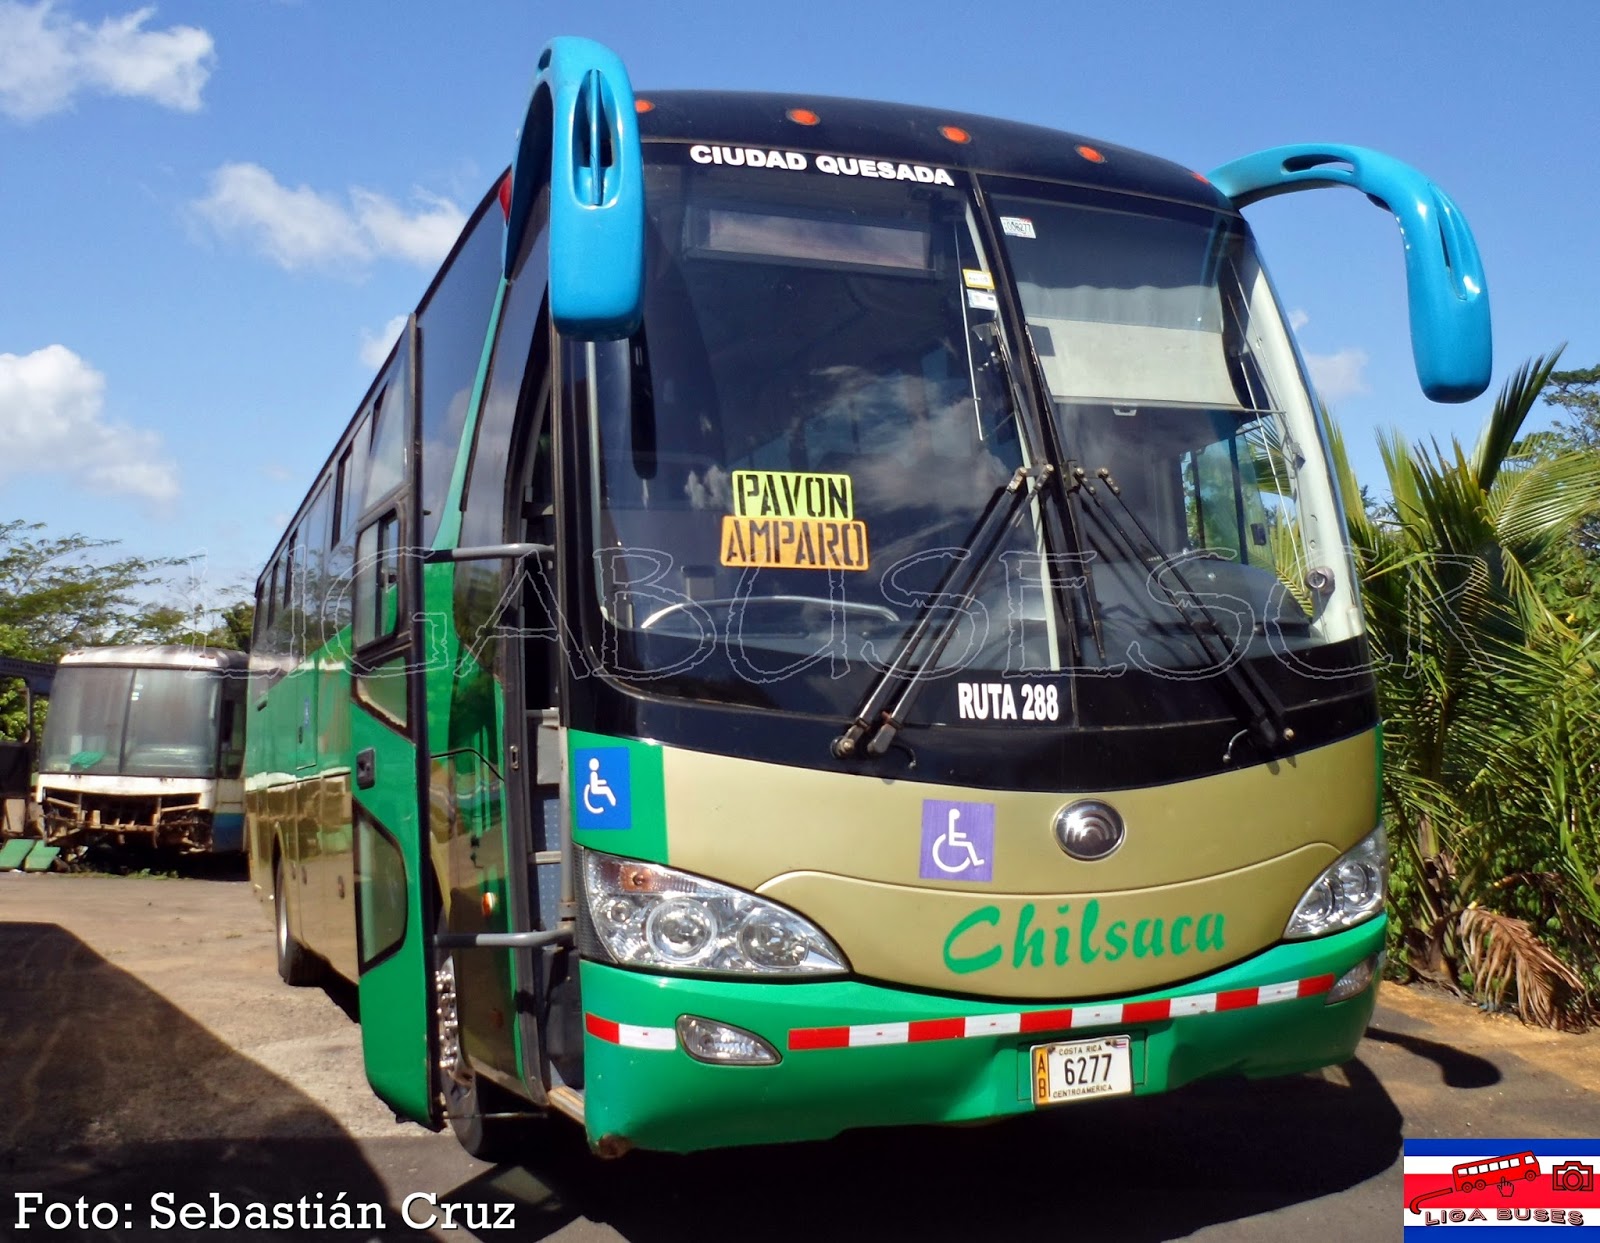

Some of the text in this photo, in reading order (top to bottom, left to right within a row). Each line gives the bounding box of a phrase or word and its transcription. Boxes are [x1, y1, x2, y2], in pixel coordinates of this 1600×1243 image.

[690, 145, 955, 187] CIUDAD QUESADA
[737, 474, 849, 519] PAVON
[726, 519, 865, 567] AMPARO
[957, 682, 1060, 721] RUTA 288
[942, 898, 1226, 975] Chilsaca
[1059, 1046, 1083, 1056] COSTA
[1064, 1054, 1112, 1085] 6277
[1053, 1085, 1112, 1098] CENTROAMERICA
